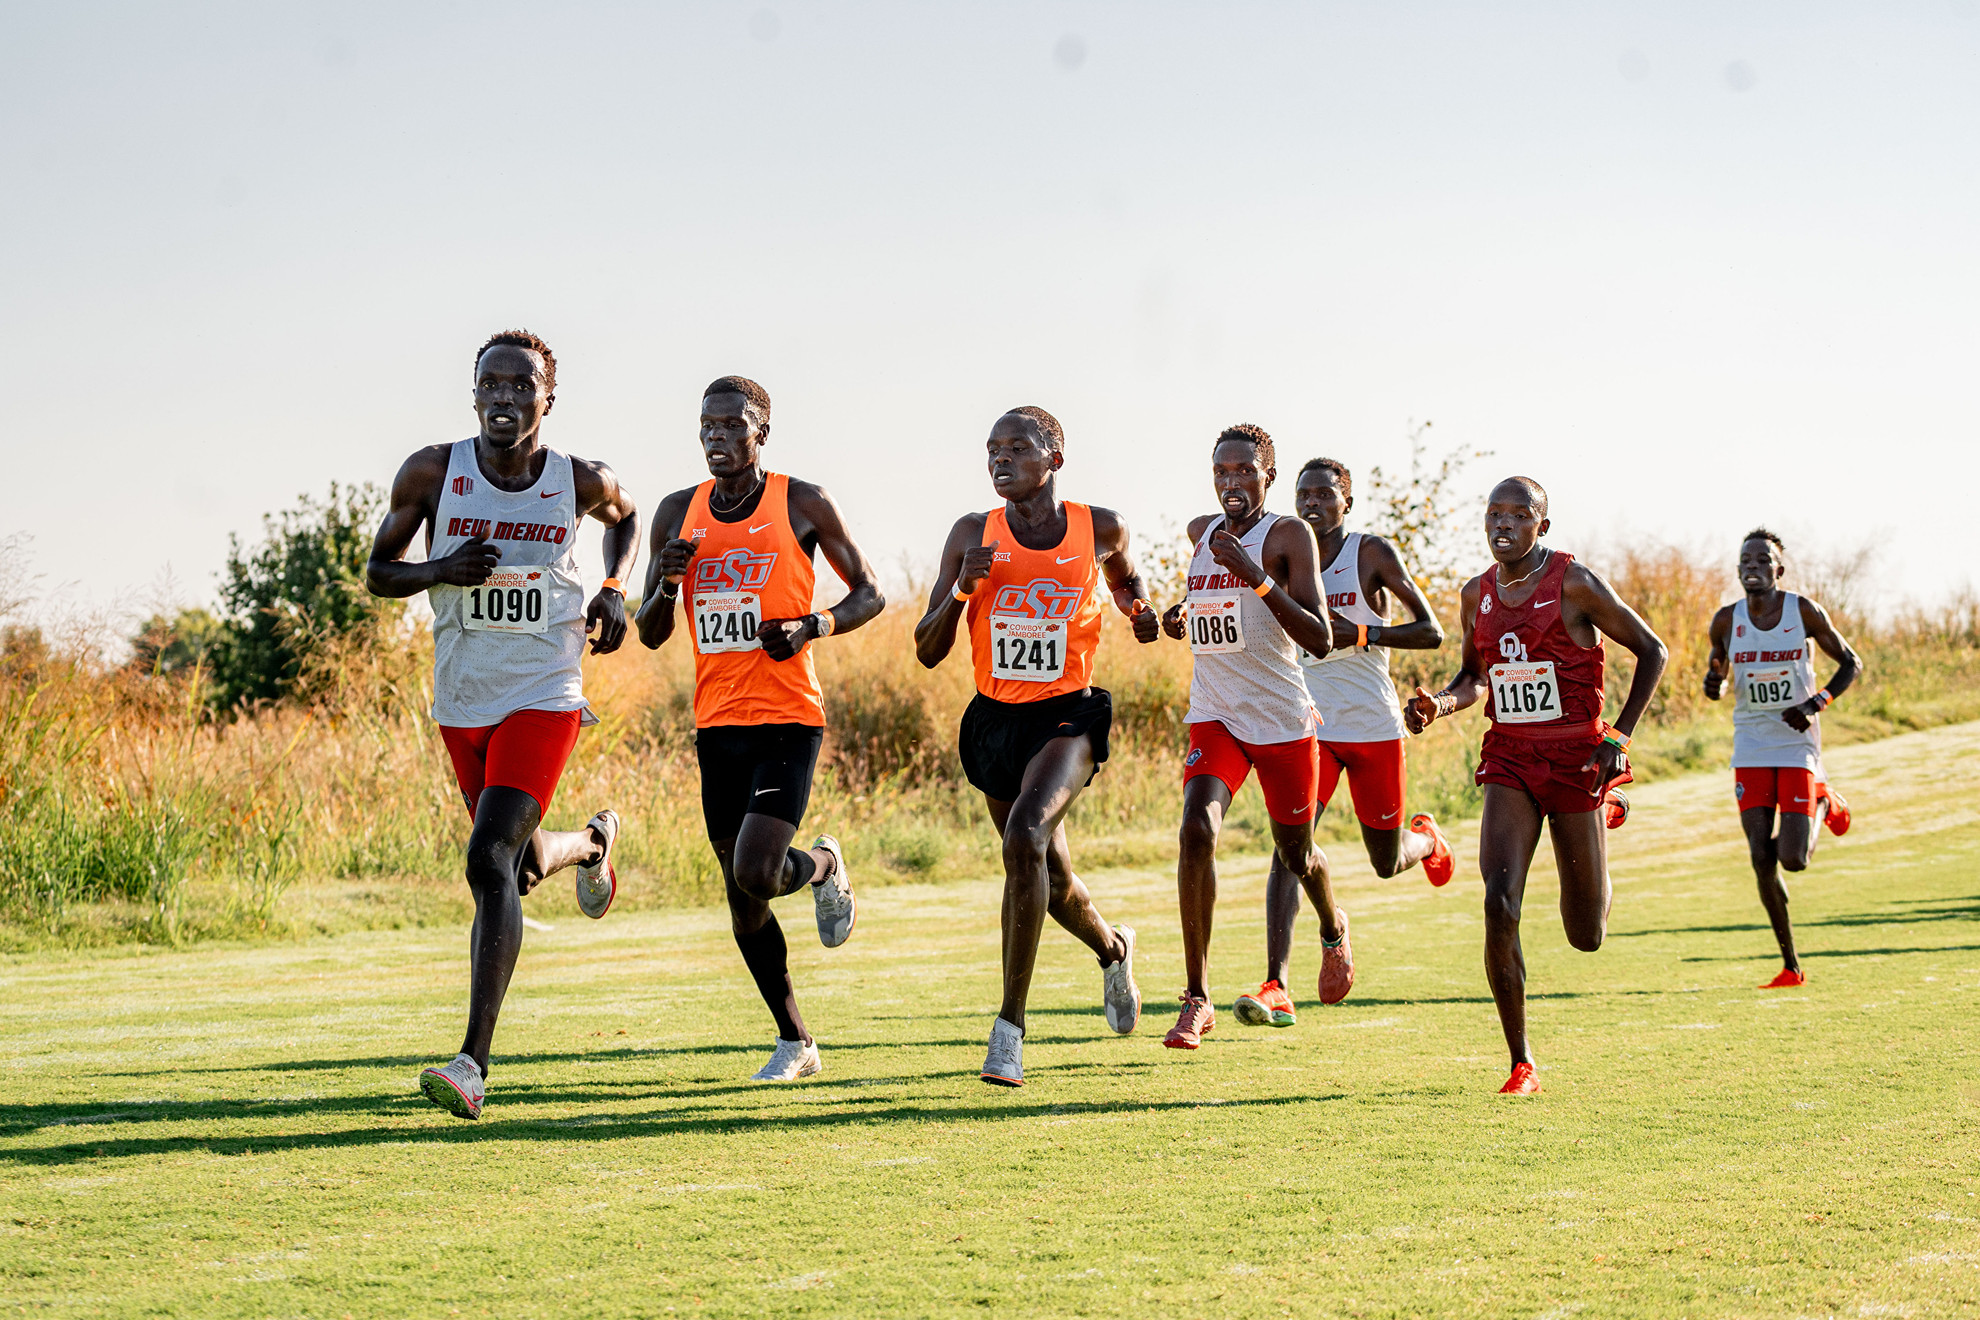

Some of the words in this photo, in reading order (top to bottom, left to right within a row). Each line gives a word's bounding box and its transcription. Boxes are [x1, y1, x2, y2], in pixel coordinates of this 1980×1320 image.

[447, 517, 491, 537] NEW
[493, 521, 567, 544] MEXICO
[695, 548, 777, 592] OSU
[470, 588, 542, 622] 1090
[991, 579, 1083, 619] OSU
[699, 611, 756, 644] 1240
[1007, 630, 1047, 639] JAMBOREE
[1009, 624, 1043, 632] COWBOY
[1190, 615, 1238, 645] 1086
[997, 637, 1059, 671] 1241
[1734, 651, 1757, 664] NEW
[1760, 648, 1803, 662] MEXICO
[1505, 675, 1537, 683] JAMBOREE
[1749, 680, 1793, 704] 1092
[1498, 681, 1555, 713] 1162
